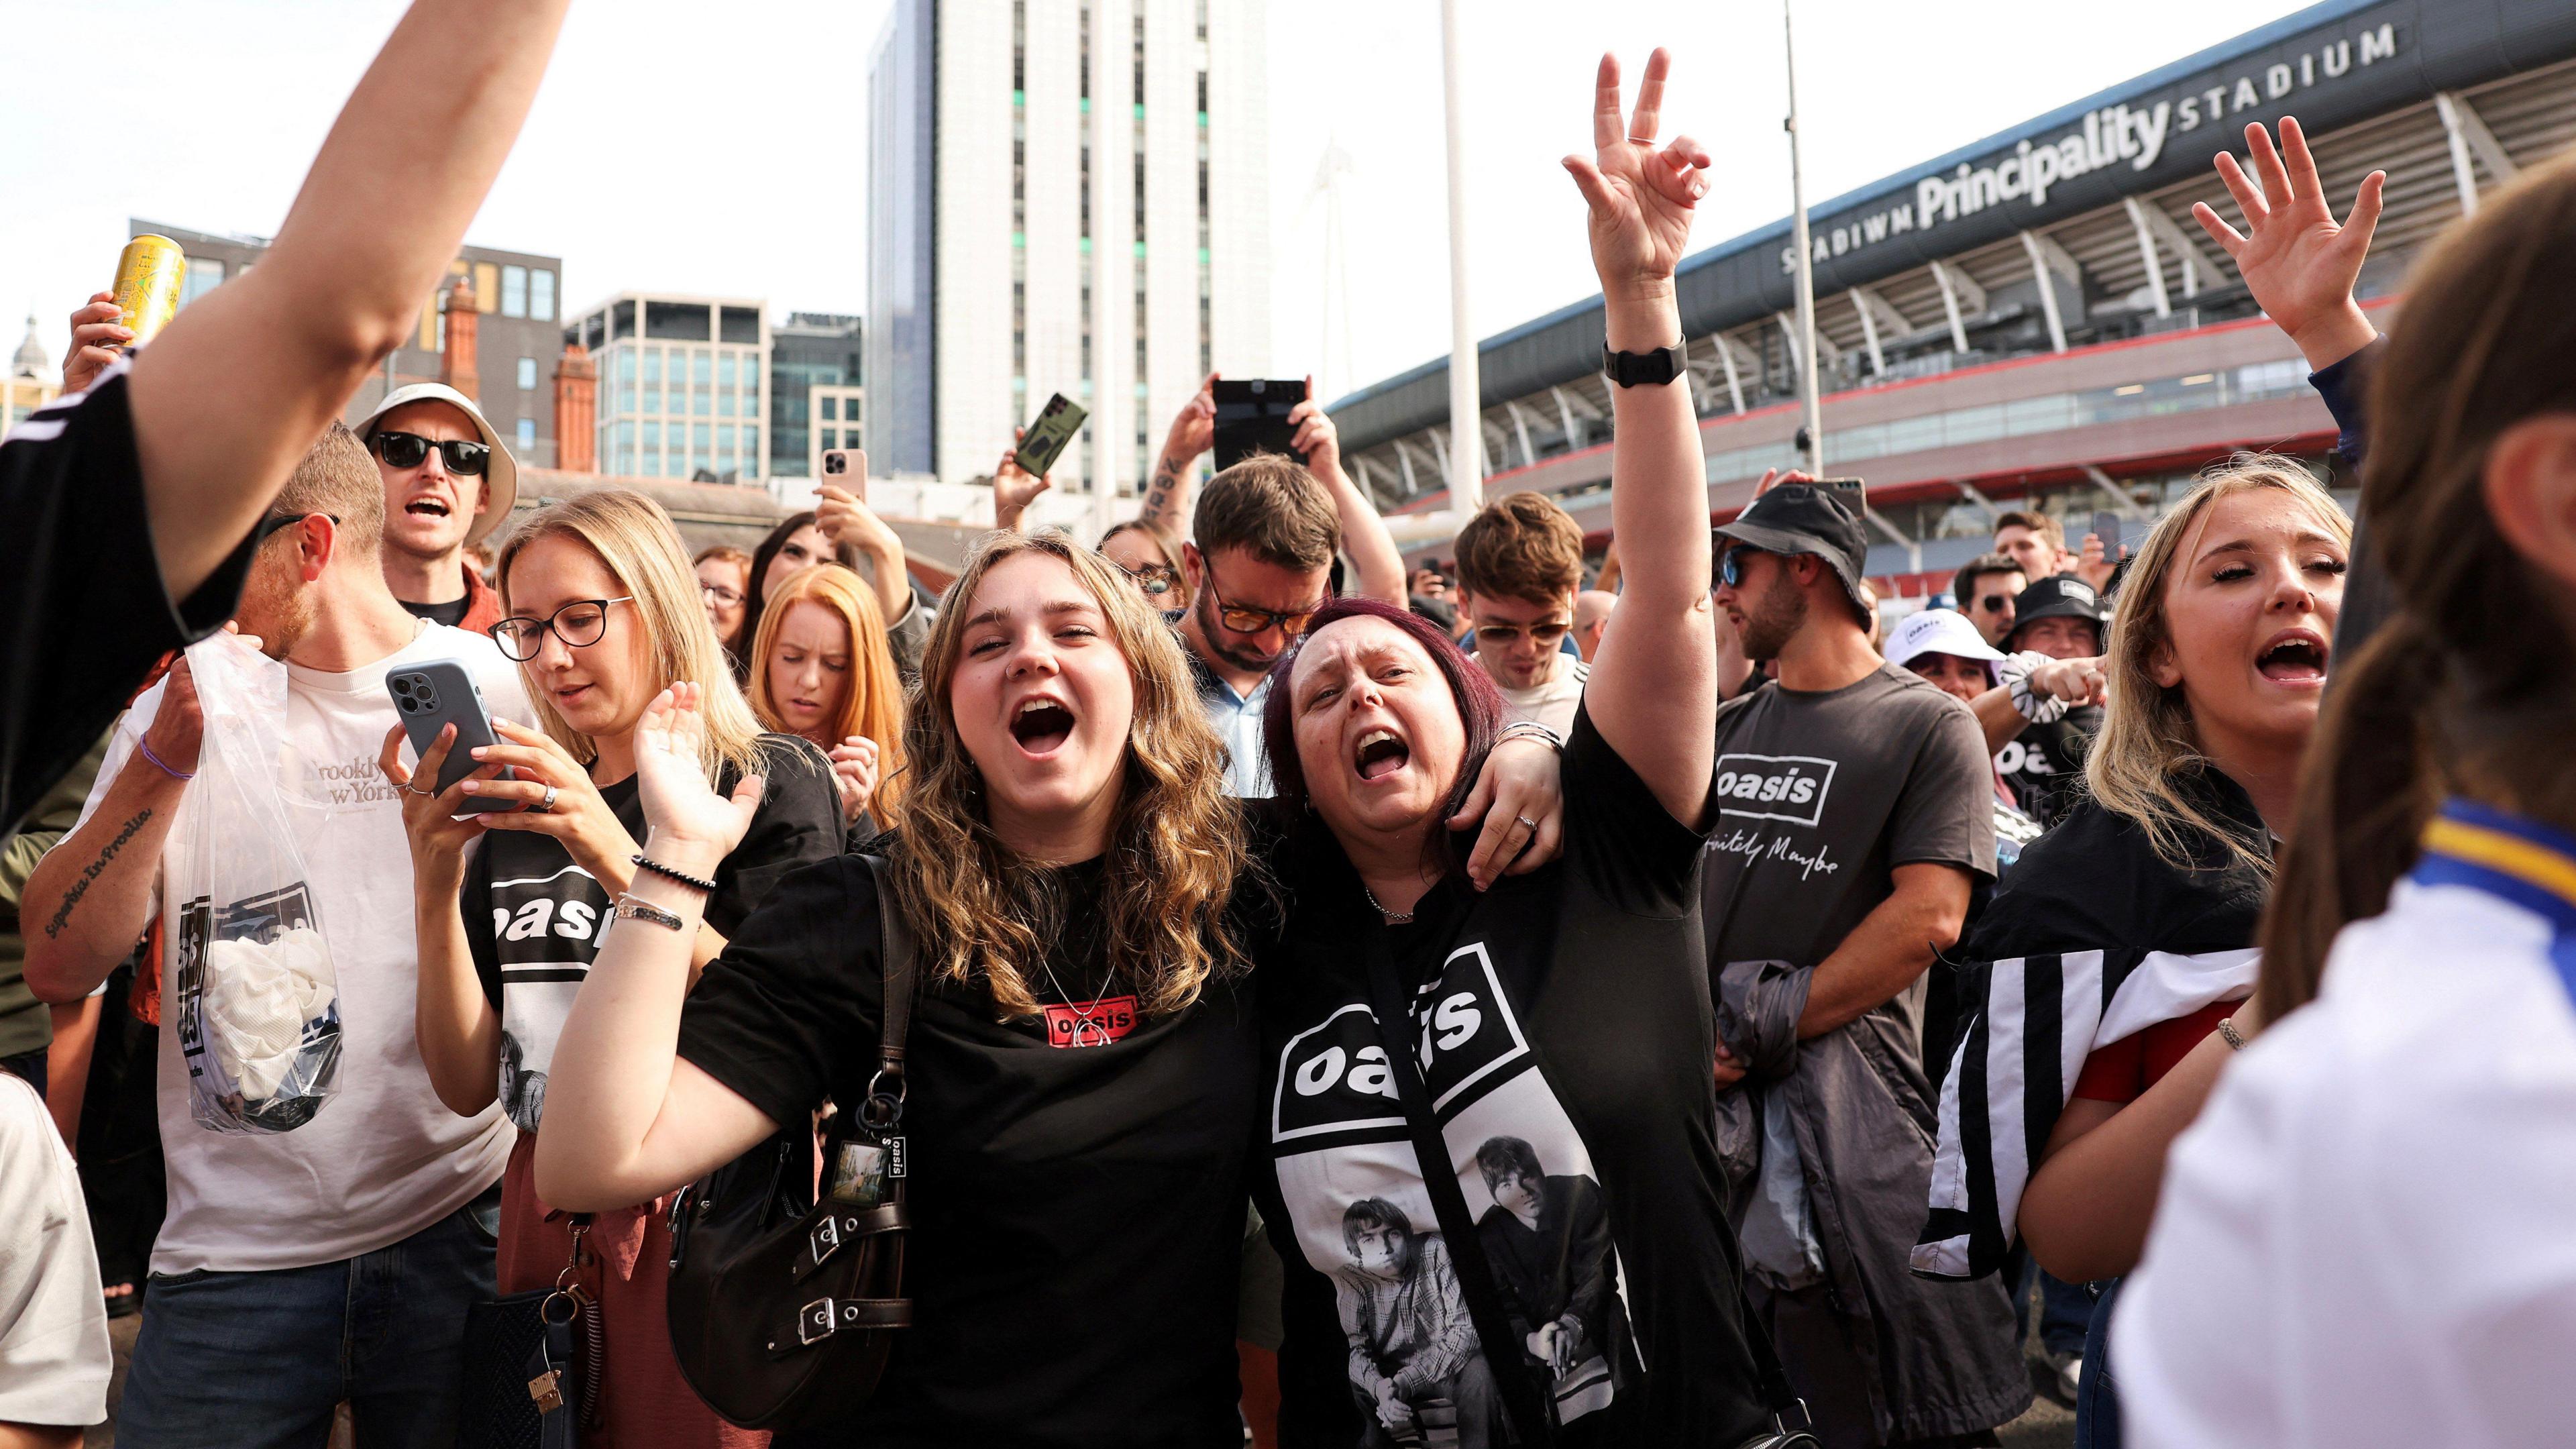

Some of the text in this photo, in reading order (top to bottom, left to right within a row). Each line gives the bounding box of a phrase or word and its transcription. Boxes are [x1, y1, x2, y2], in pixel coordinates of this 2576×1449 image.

[1781, 22, 2397, 274] SADIWM Principality STADIUM
[318, 755, 382, 783] rookly
[1717, 767, 1817, 804] oasis
[1766, 835, 1839, 881] Maybe
[1295, 991, 1482, 1101] oais
[892, 1140, 904, 1175] oasis
